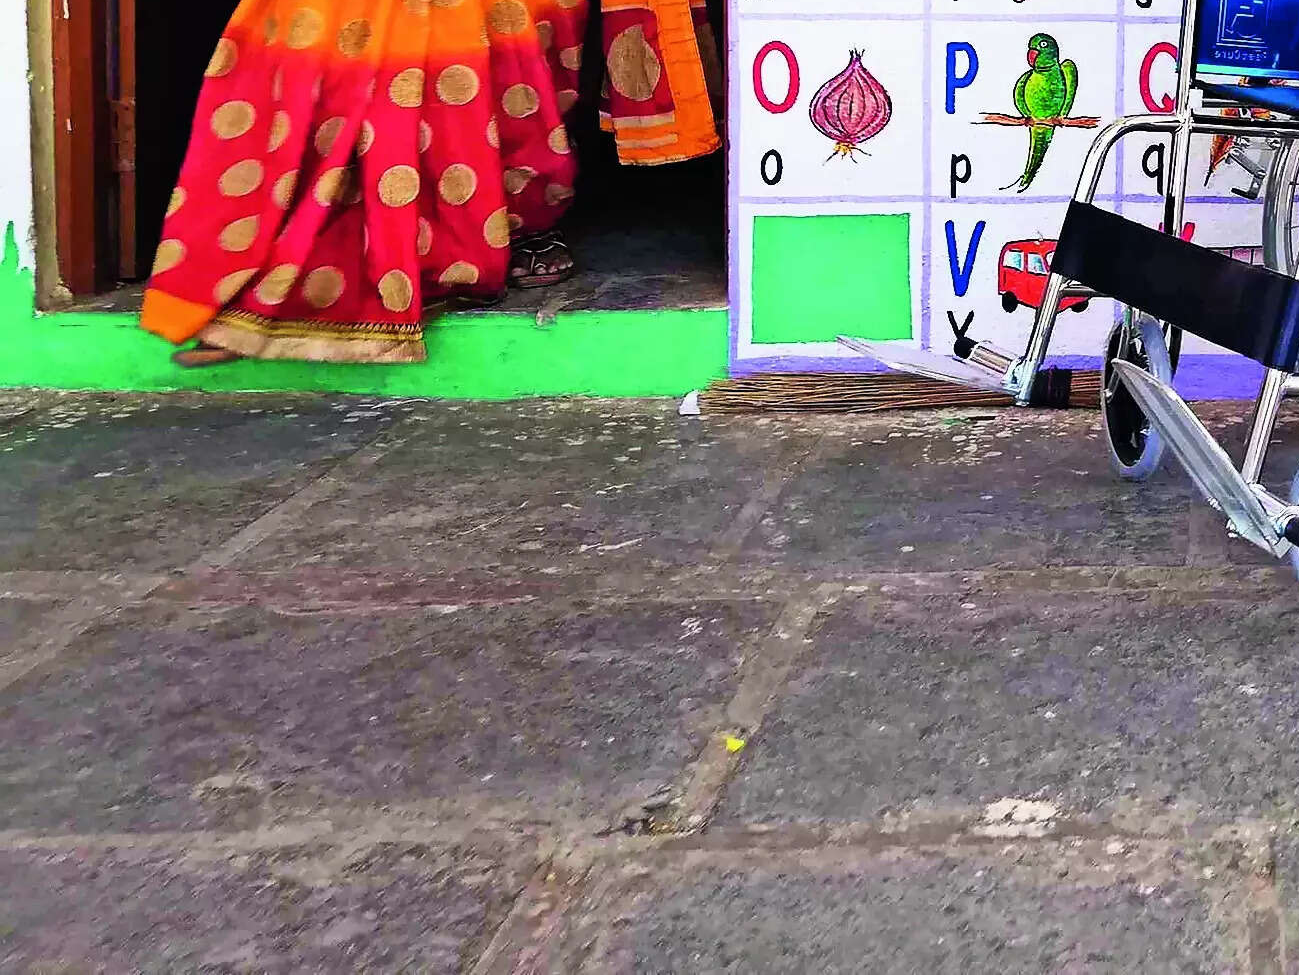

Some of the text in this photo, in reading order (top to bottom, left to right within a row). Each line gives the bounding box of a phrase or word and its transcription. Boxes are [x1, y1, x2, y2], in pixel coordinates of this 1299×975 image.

[752, 40, 800, 114] O
[946, 41, 979, 114] P
[949, 151, 972, 198] p
[1142, 141, 1165, 195] q
[945, 219, 986, 297] V
